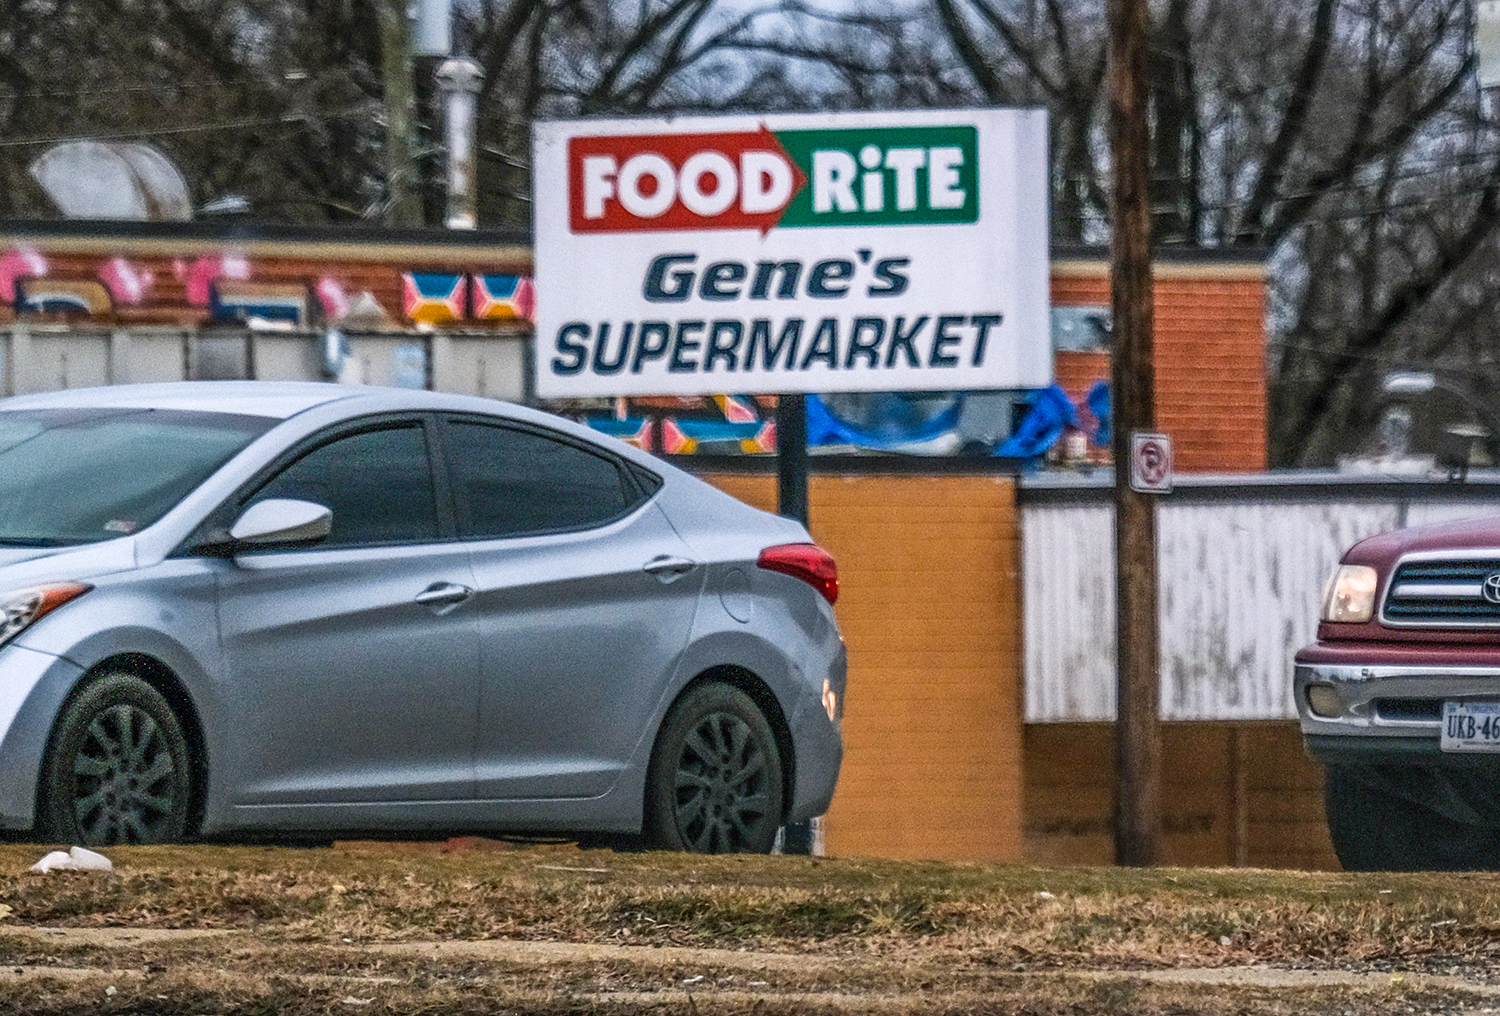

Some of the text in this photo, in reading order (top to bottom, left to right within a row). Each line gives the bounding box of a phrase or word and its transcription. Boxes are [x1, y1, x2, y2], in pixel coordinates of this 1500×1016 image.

[583, 151, 793, 219] FOOD
[643, 248, 911, 303] Gene's
[550, 314, 1003, 376] SUPERMARKET
